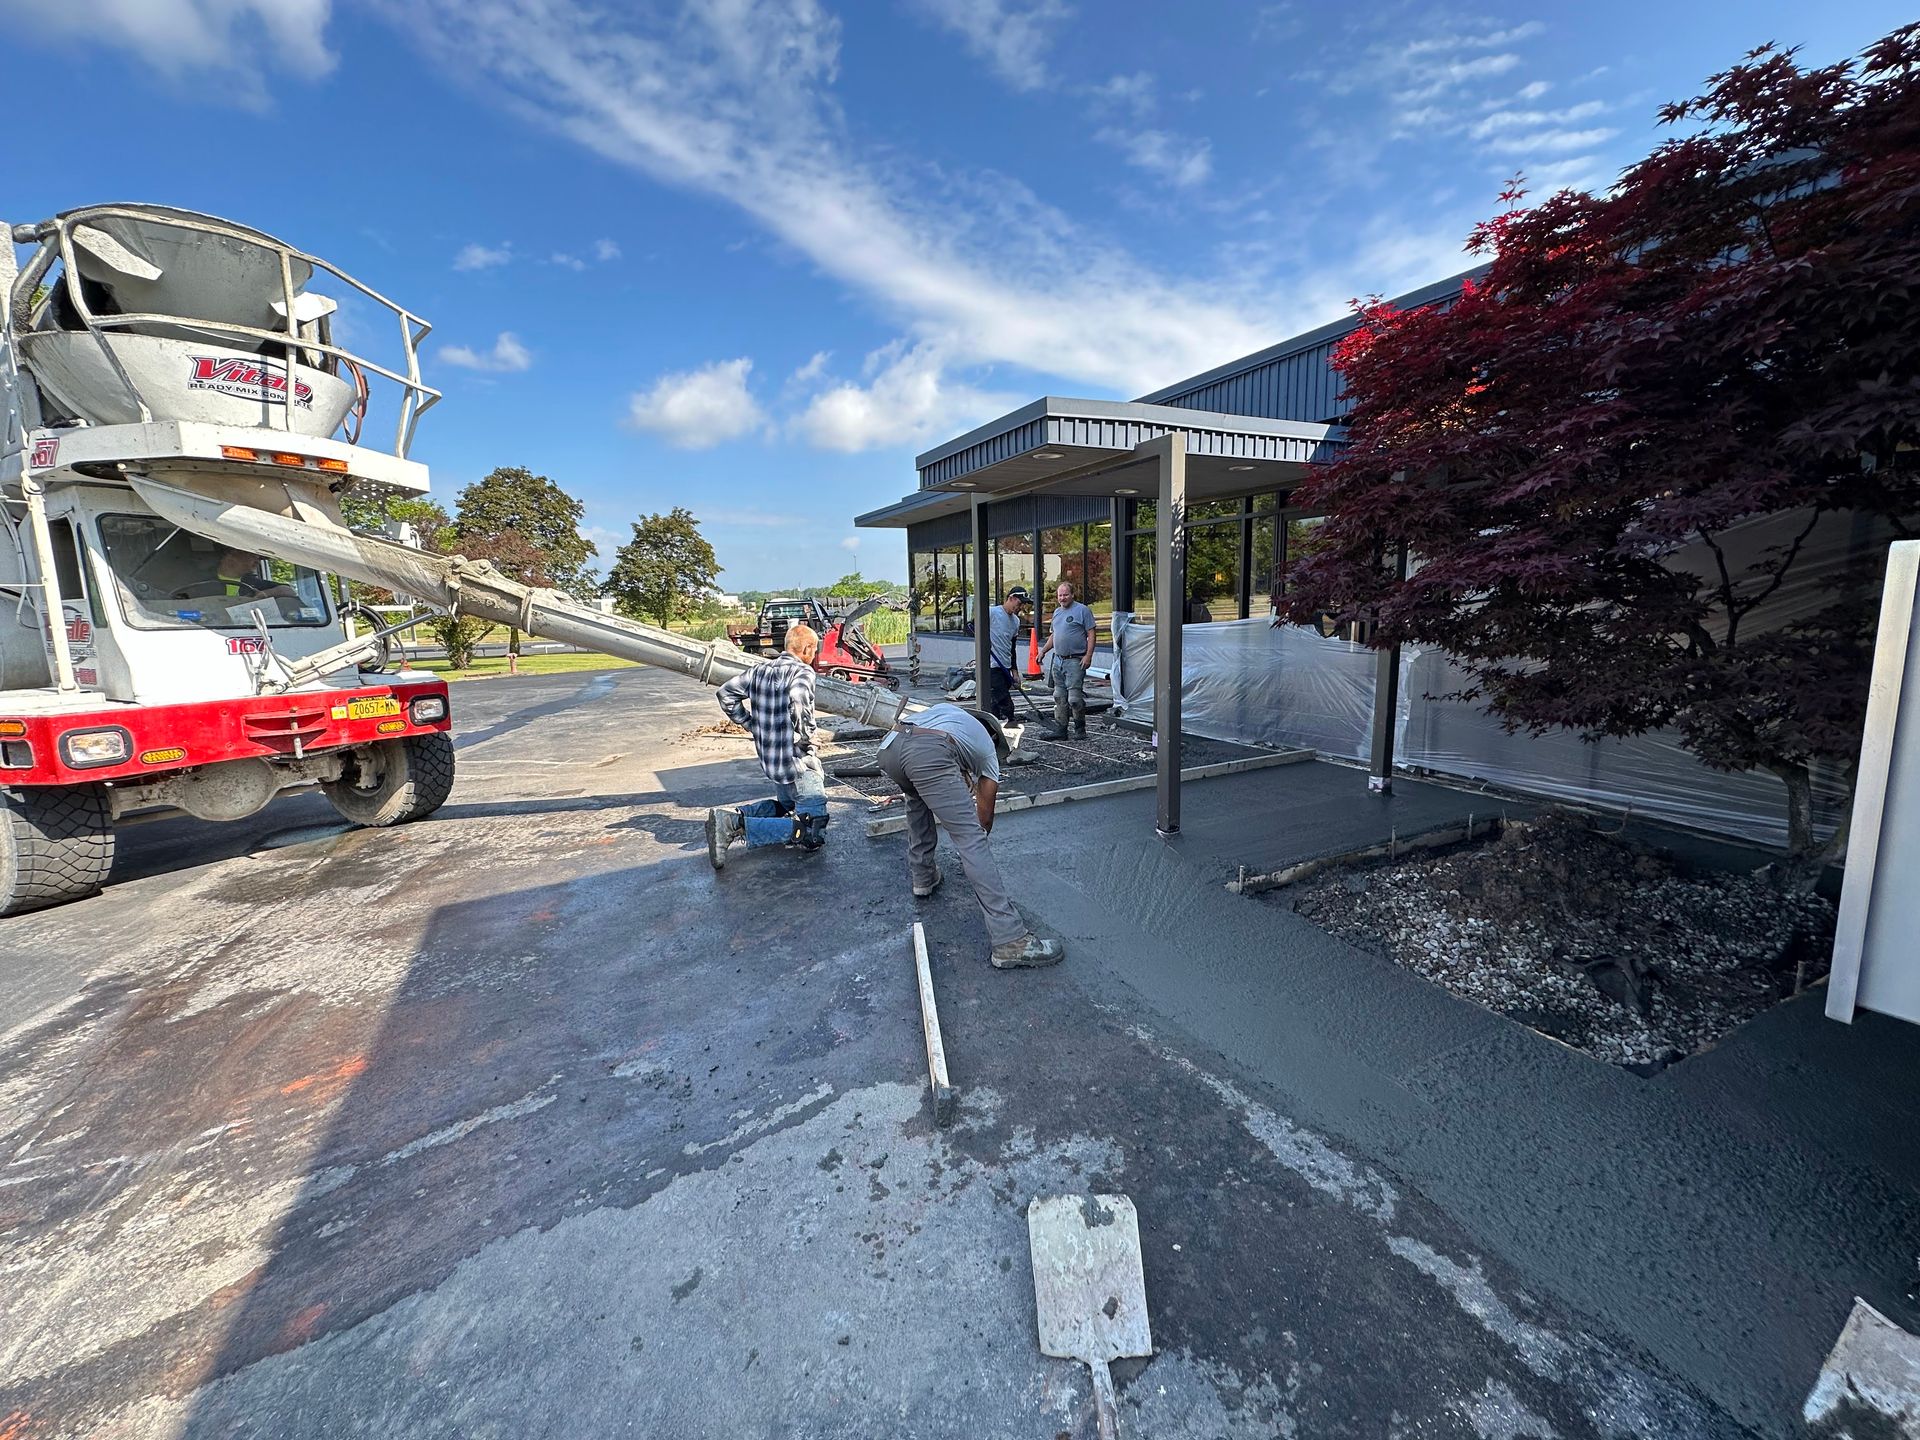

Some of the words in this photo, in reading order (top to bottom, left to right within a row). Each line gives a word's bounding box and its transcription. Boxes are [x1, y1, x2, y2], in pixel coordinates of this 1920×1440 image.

[189, 383, 233, 391] READY
[236, 386, 258, 395] MIX
[190, 356, 313, 402] Vitae
